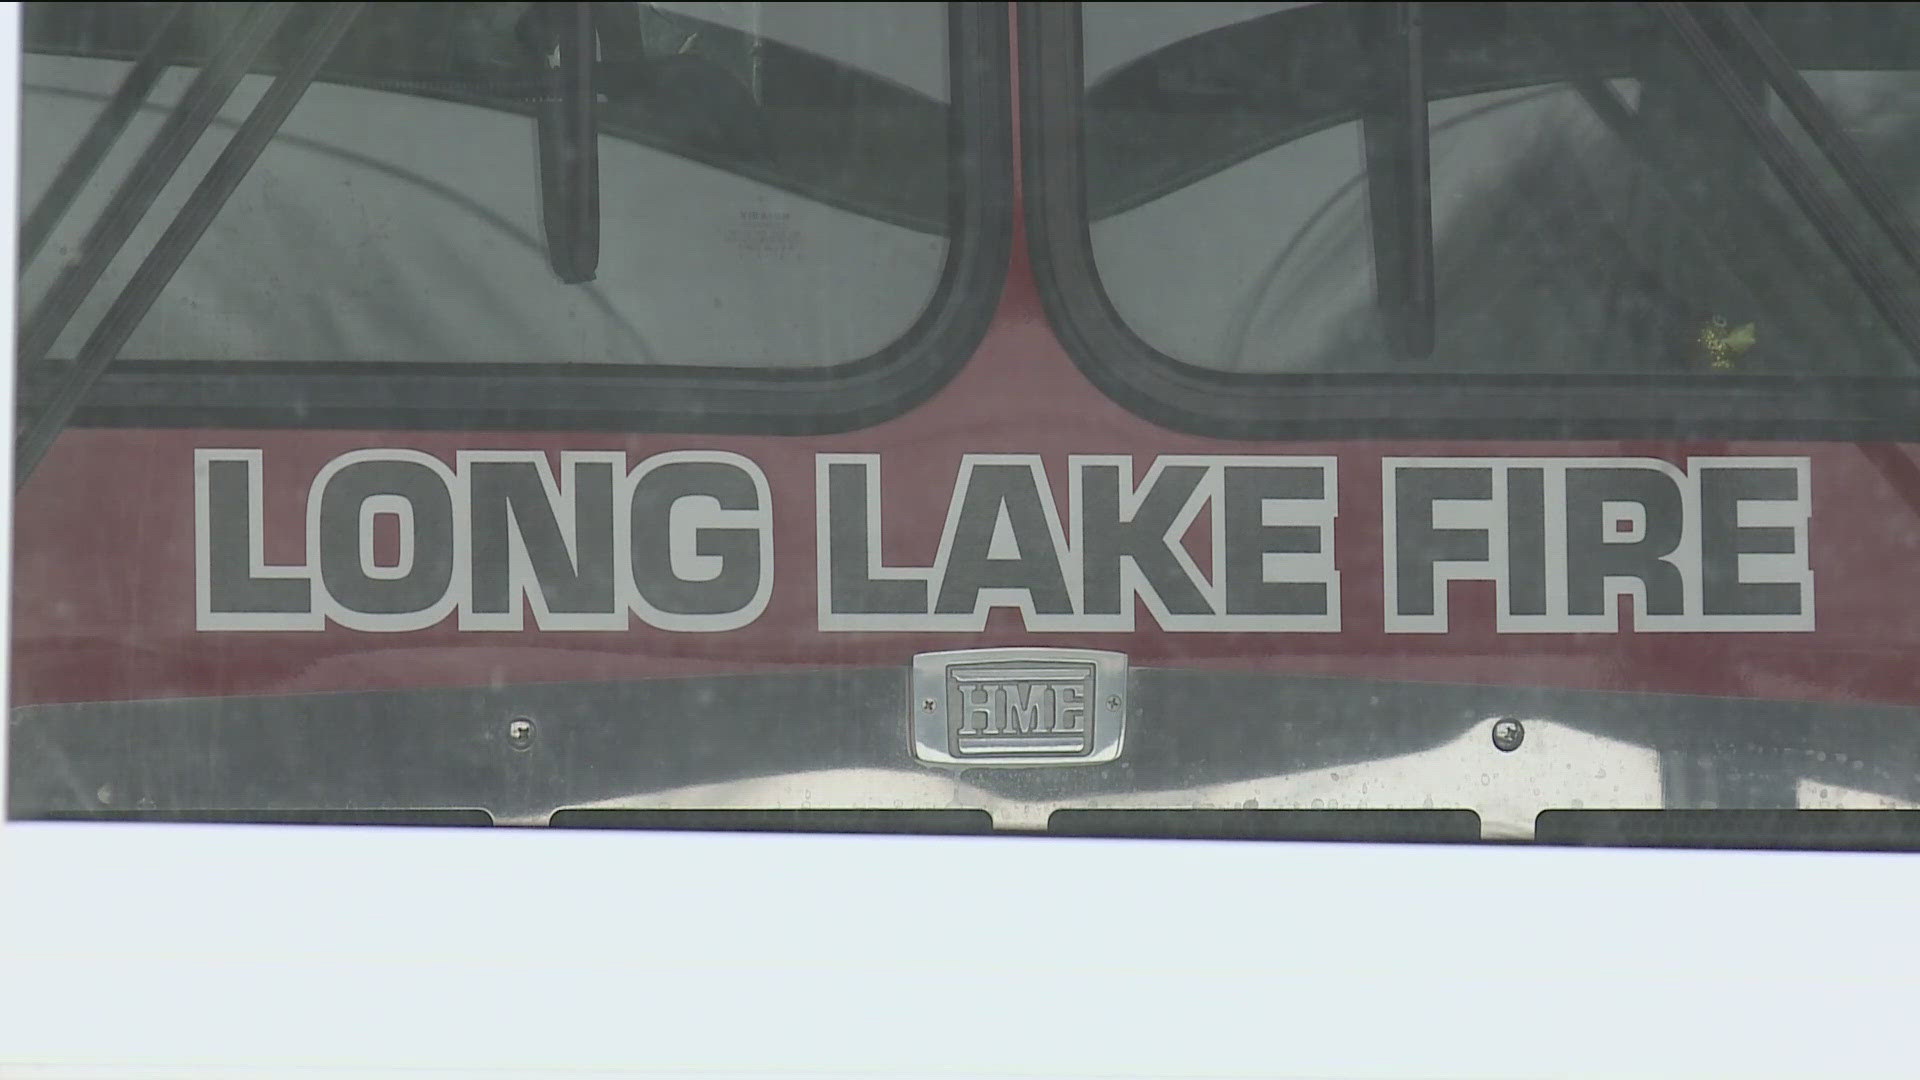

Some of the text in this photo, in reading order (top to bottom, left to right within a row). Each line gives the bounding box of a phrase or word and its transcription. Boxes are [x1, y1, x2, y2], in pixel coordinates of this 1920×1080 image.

[195, 448, 1815, 633] LONG LAKE FIRE
[957, 683, 1085, 735] HME
